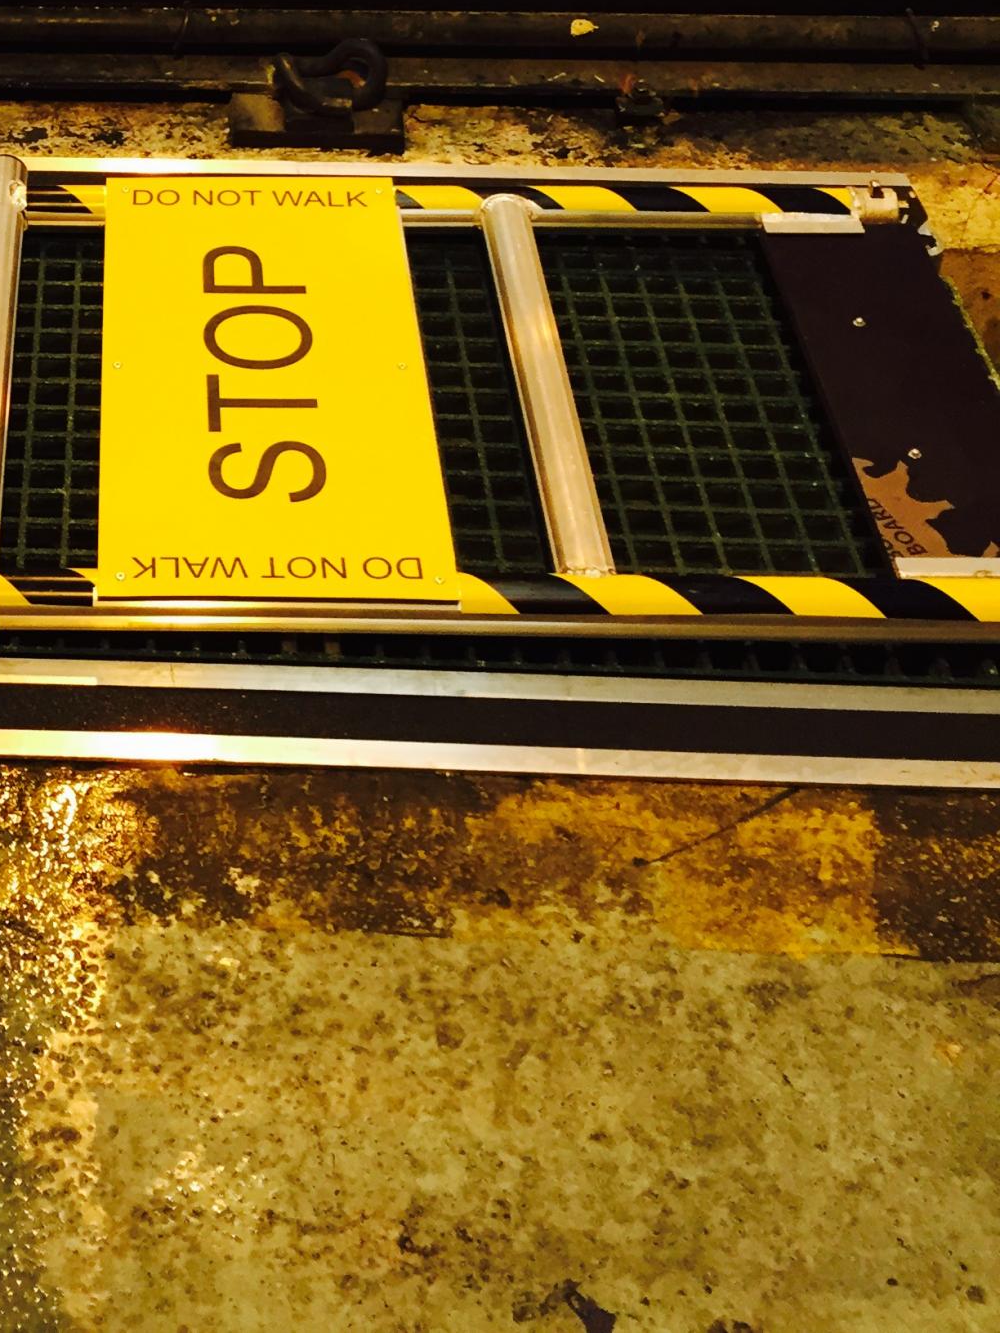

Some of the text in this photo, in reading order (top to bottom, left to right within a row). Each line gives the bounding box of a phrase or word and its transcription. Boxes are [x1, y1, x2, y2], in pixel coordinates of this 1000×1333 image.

[133, 190, 367, 207] DO NOT WALK
[203, 246, 326, 502] STOP
[132, 557, 423, 579] DO NOT WALK
